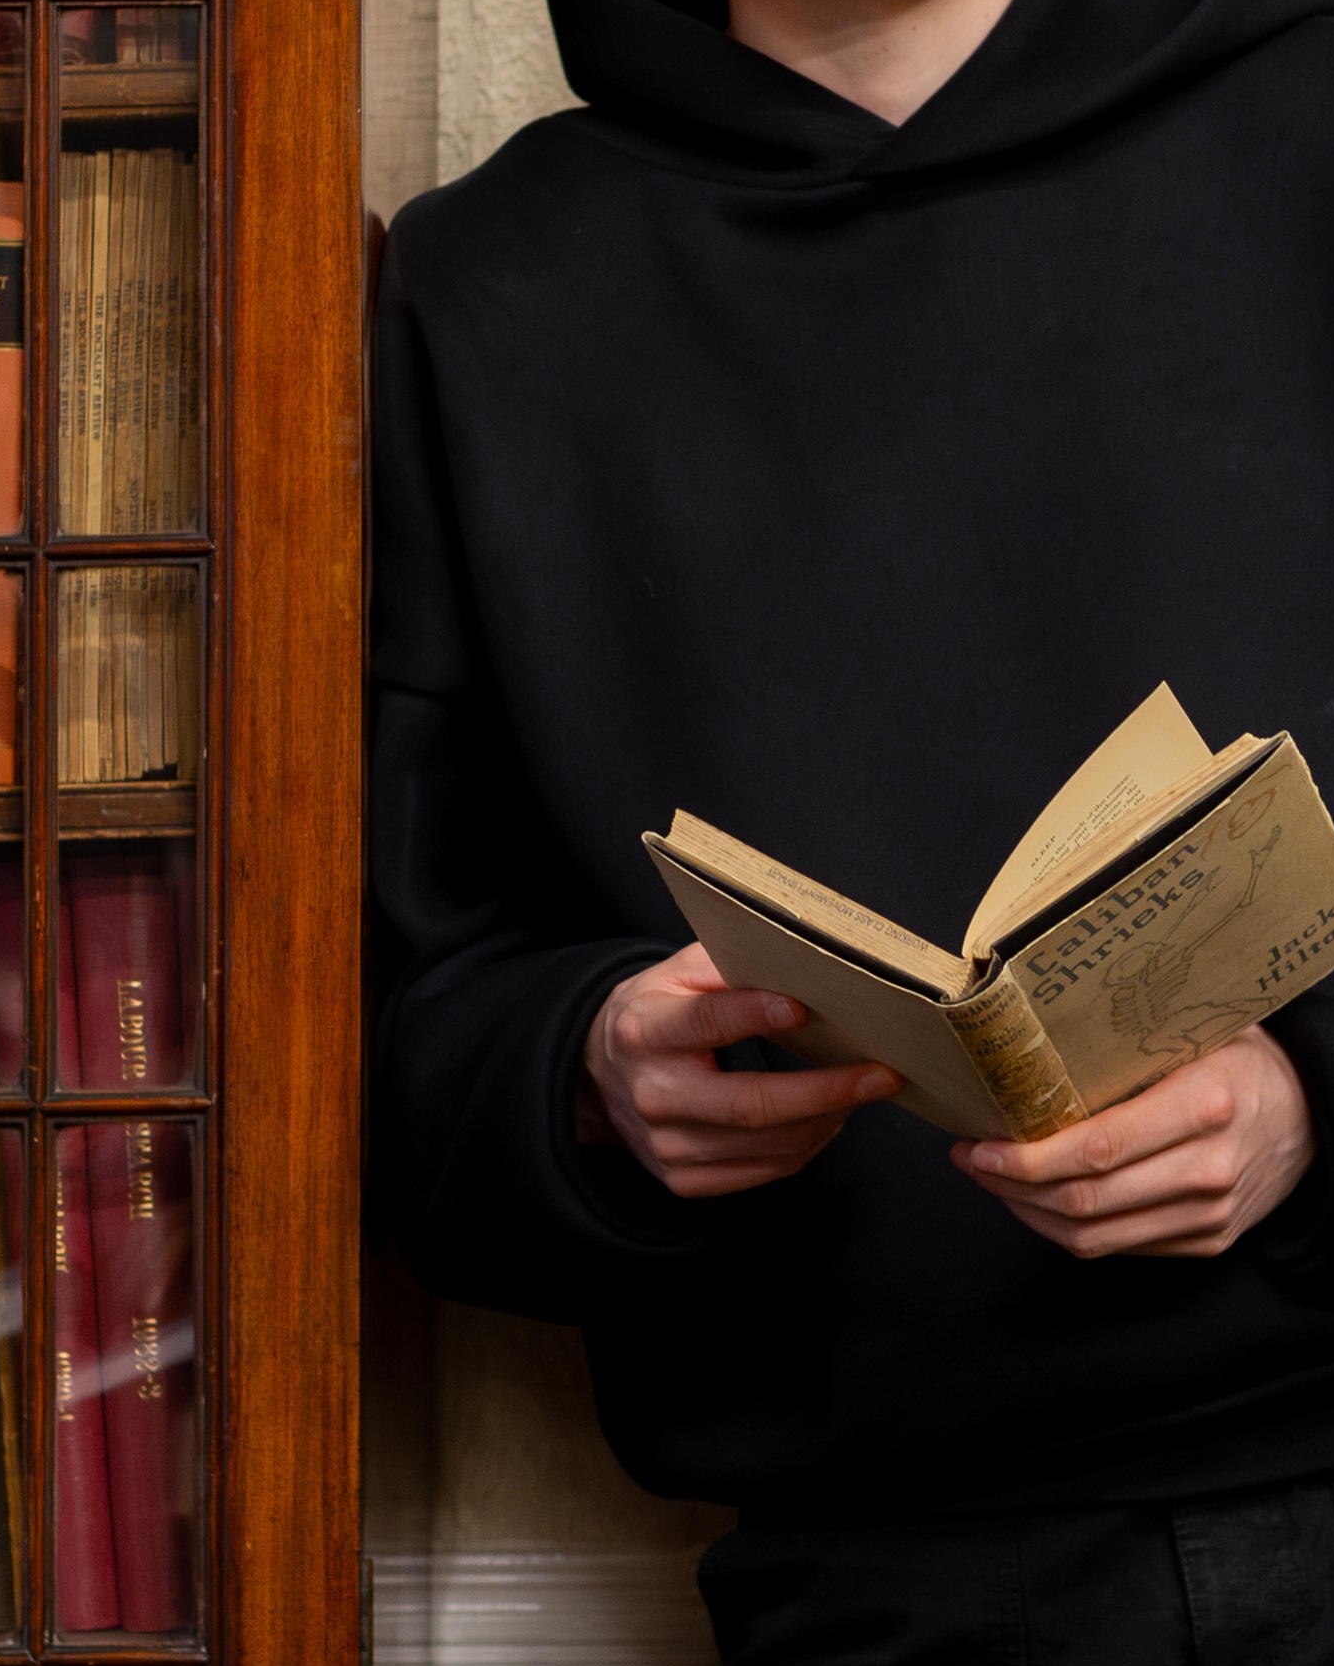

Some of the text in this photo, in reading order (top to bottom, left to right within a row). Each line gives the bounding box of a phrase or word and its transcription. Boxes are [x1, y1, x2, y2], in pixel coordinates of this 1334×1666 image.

[853, 911, 885, 934] CLASS
[1026, 842, 1199, 978] Caliban
[1032, 867, 1205, 1005] Shrieks
[117, 978, 149, 1082] LABOUR
